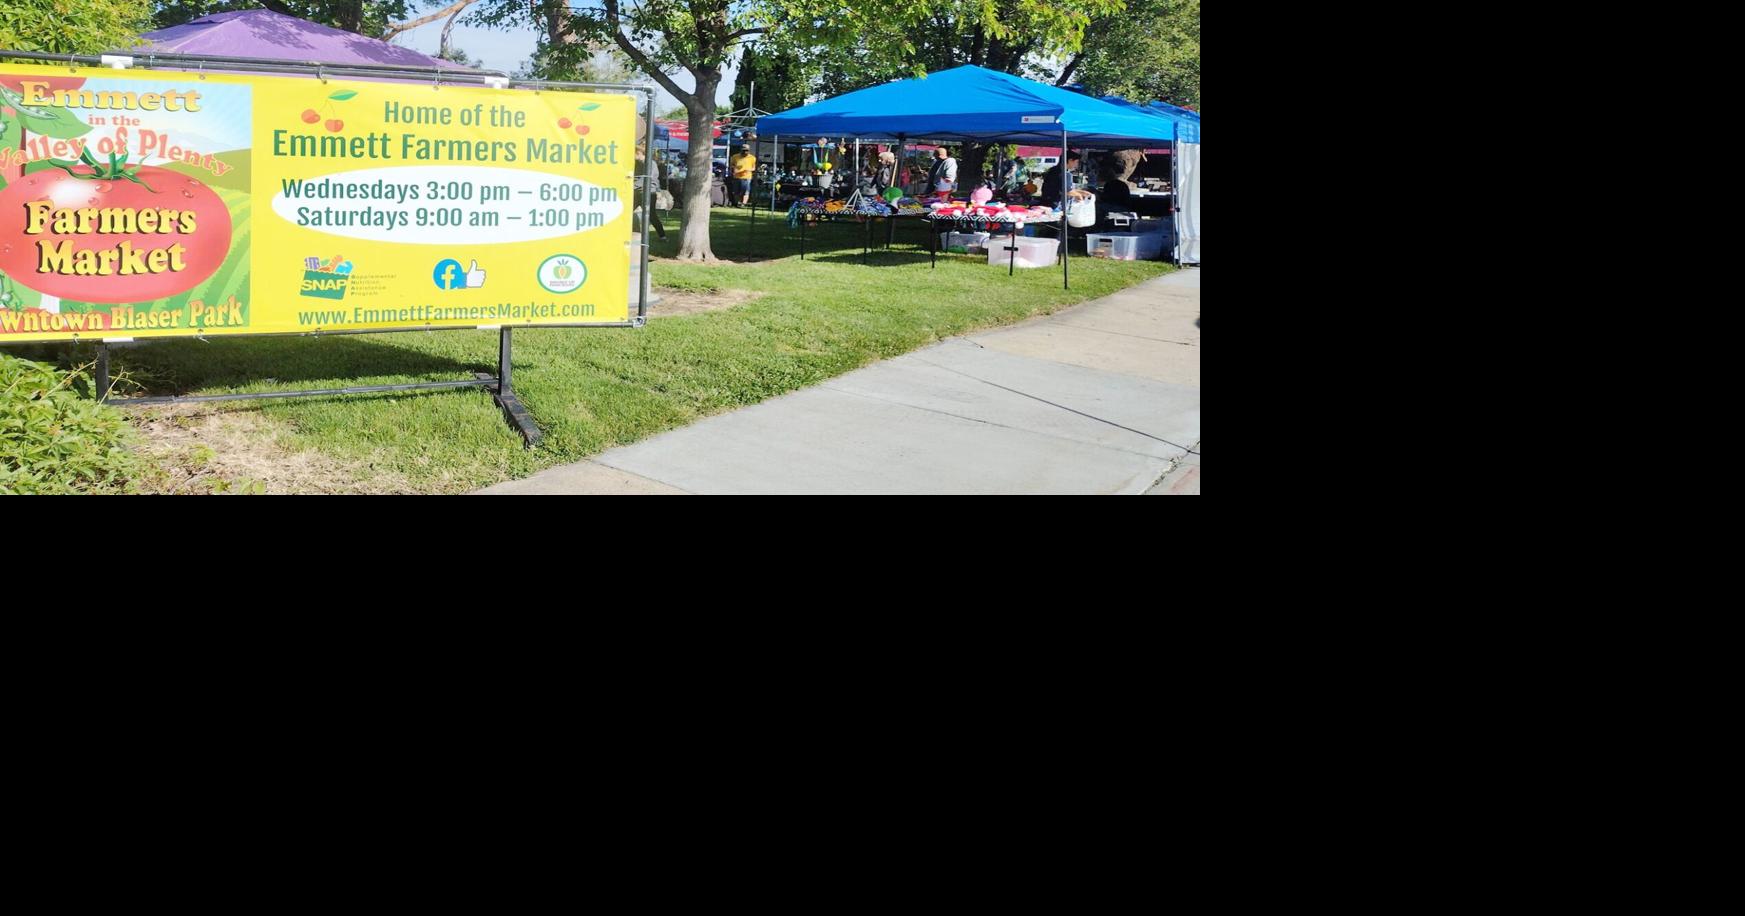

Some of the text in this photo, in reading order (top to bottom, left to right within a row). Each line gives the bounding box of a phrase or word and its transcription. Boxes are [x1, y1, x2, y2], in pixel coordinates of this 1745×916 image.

[20, 81, 202, 112] Emmett
[88, 114, 141, 127] in the
[384, 101, 526, 128] Home of the
[97, 126, 129, 156] of
[138, 129, 233, 176] Plenty
[273, 129, 618, 165] Emmett Farmers Market
[282, 178, 420, 204] Wednesdays
[426, 181, 473, 201] 3:00
[480, 185, 510, 205] pm
[539, 183, 583, 202] 6:00
[589, 187, 618, 206] pm
[24, 200, 197, 235] Farmers
[296, 206, 409, 231] Saturdays
[415, 208, 463, 227] 9:00
[468, 212, 499, 227] am
[528, 208, 570, 227] 1:00
[575, 212, 605, 231] pm
[35, 239, 187, 276] Market
[302, 279, 347, 291] SNAP
[110, 305, 183, 330] Blaser
[188, 295, 244, 327] Park
[299, 302, 595, 325] www.EmmettFarmersMarket.com
